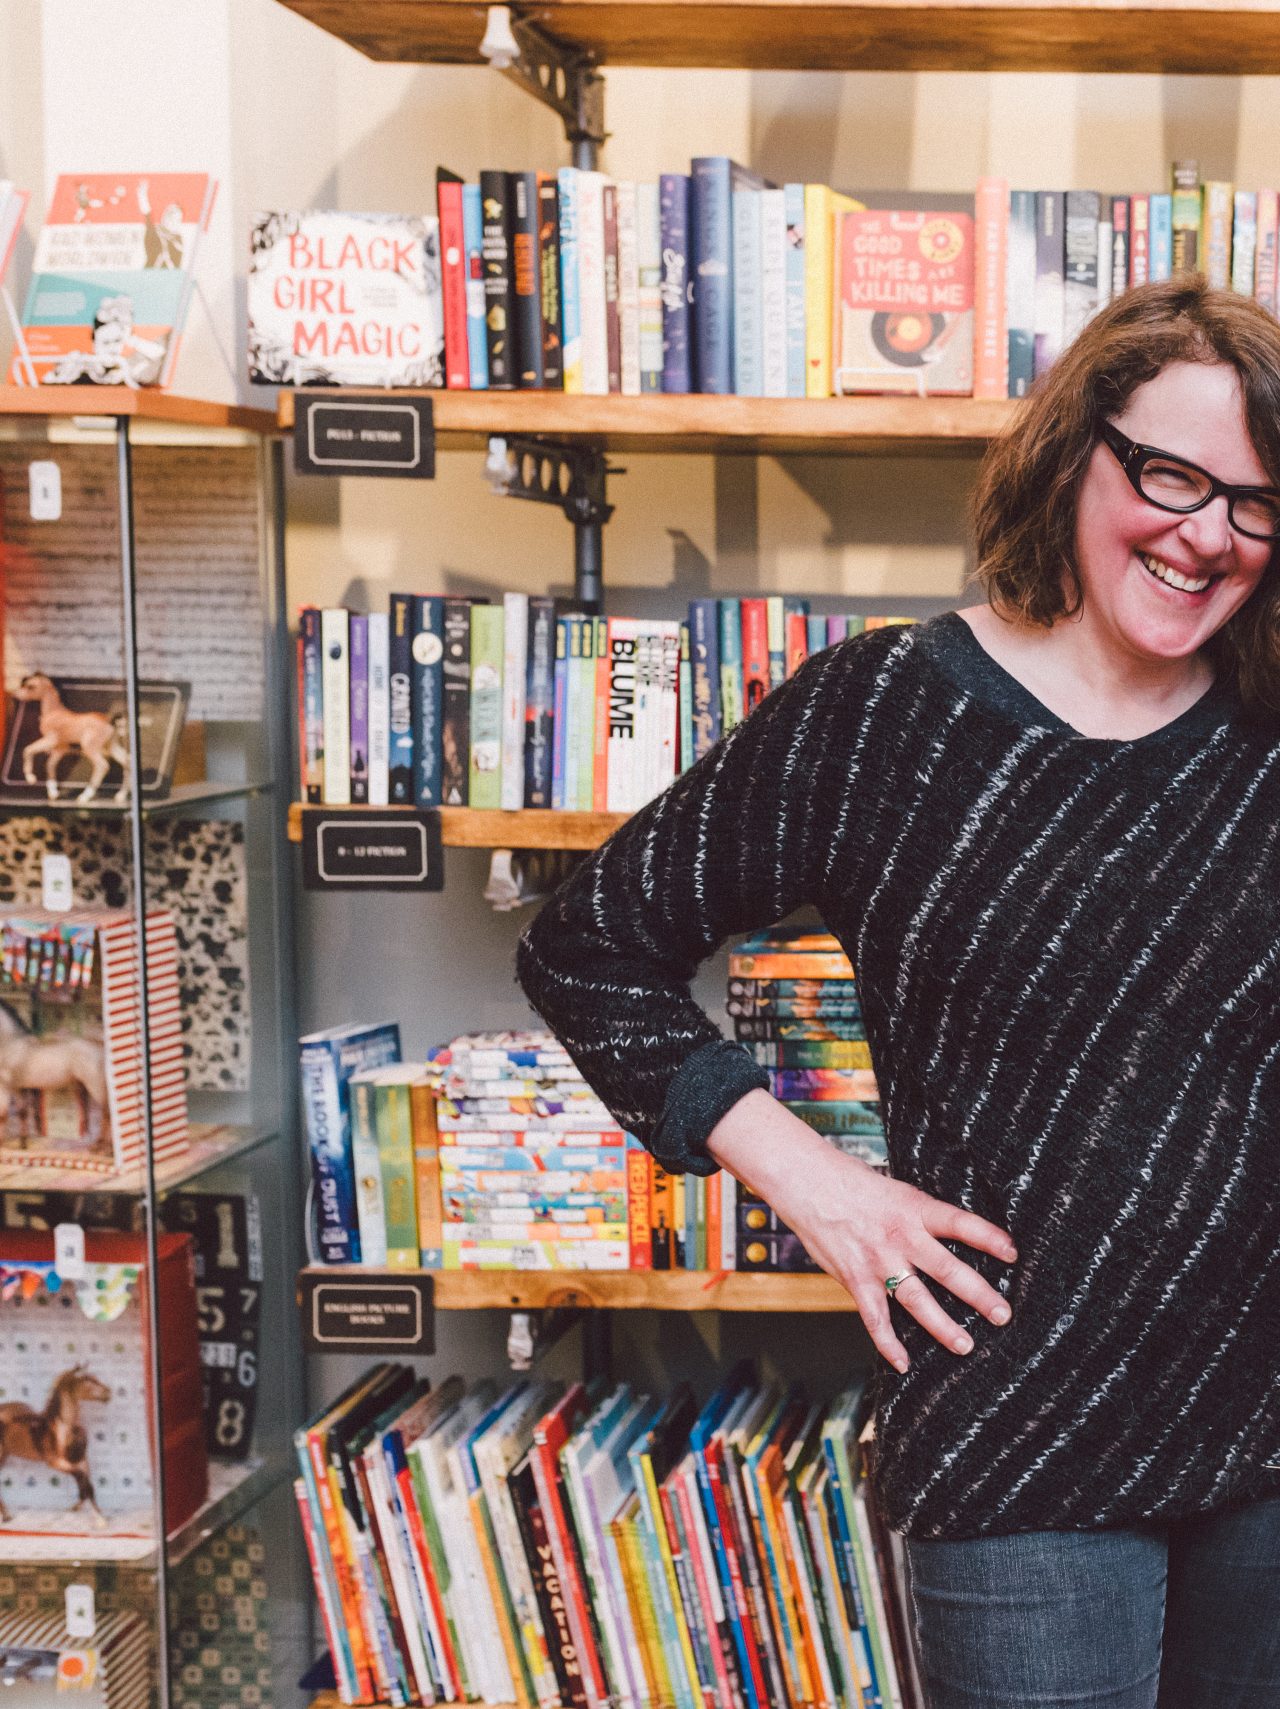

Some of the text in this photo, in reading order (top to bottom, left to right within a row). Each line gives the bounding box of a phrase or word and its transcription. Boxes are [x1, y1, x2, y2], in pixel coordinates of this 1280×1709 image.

[288, 234, 417, 273] BLACK
[854, 256, 920, 281] TIMES
[273, 275, 355, 314] GIRL
[851, 281, 965, 306] KILLING ME
[292, 320, 421, 357] MAGIC
[610, 639, 636, 739] BLUME
[313, 1102, 330, 1148] BOOK
[319, 1178, 341, 1227] DUST
[237, 1351, 257, 1387] 6
[215, 1399, 245, 1447] 8
[536, 1545, 579, 1677] VACATION
